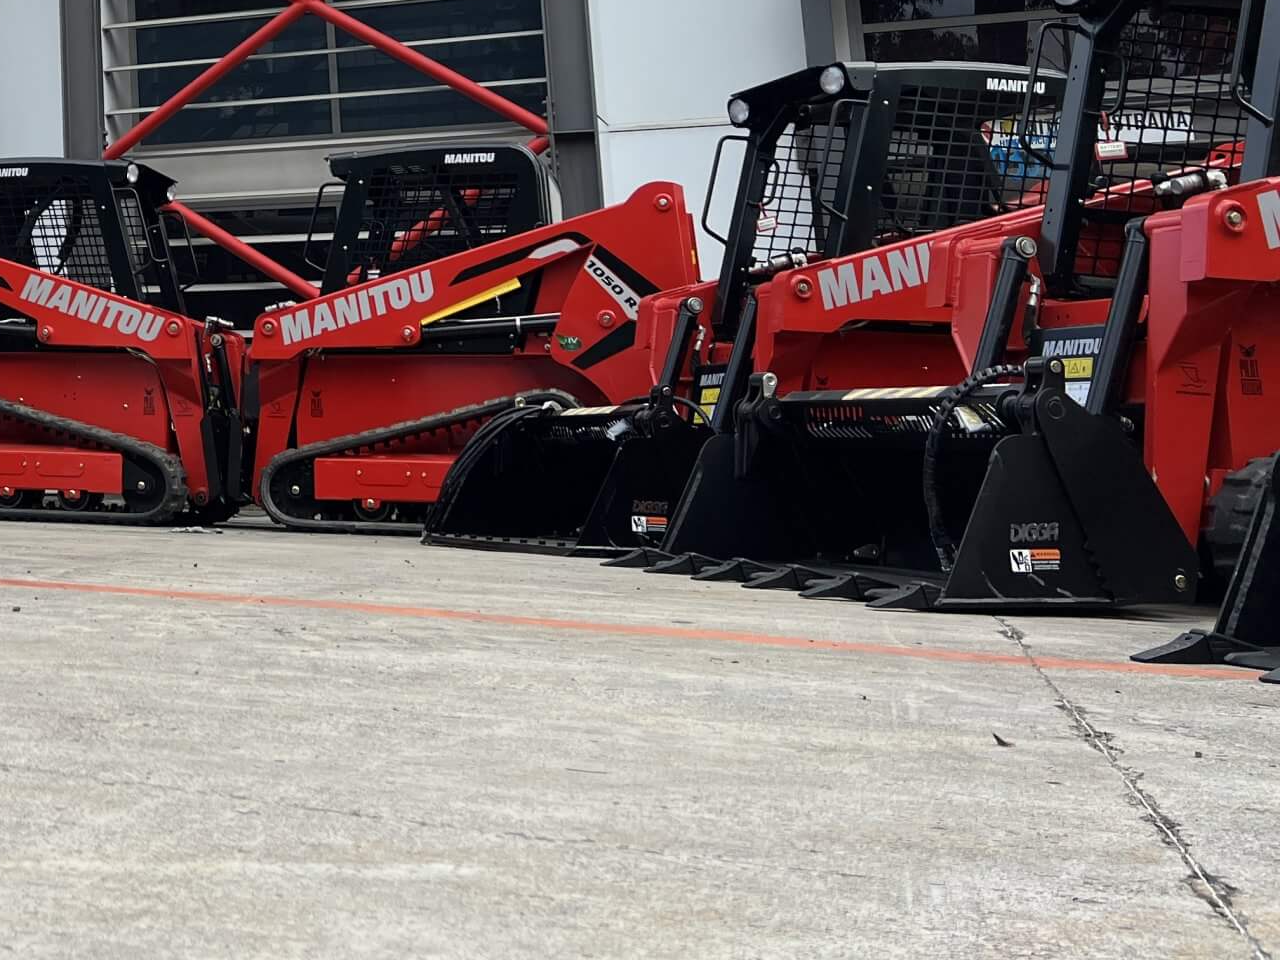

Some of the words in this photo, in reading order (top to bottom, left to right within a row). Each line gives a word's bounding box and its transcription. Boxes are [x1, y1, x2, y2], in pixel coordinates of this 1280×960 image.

[444, 152, 496, 164] MANITOU
[587, 259, 624, 295] 1050
[624, 296, 639, 314] R
[817, 242, 930, 311] MANI
[20, 273, 165, 342] MANITOU
[280, 269, 434, 346] MANITOU
[1042, 337, 1103, 357] MANITOU
[1010, 522, 1060, 543] DIGGA
